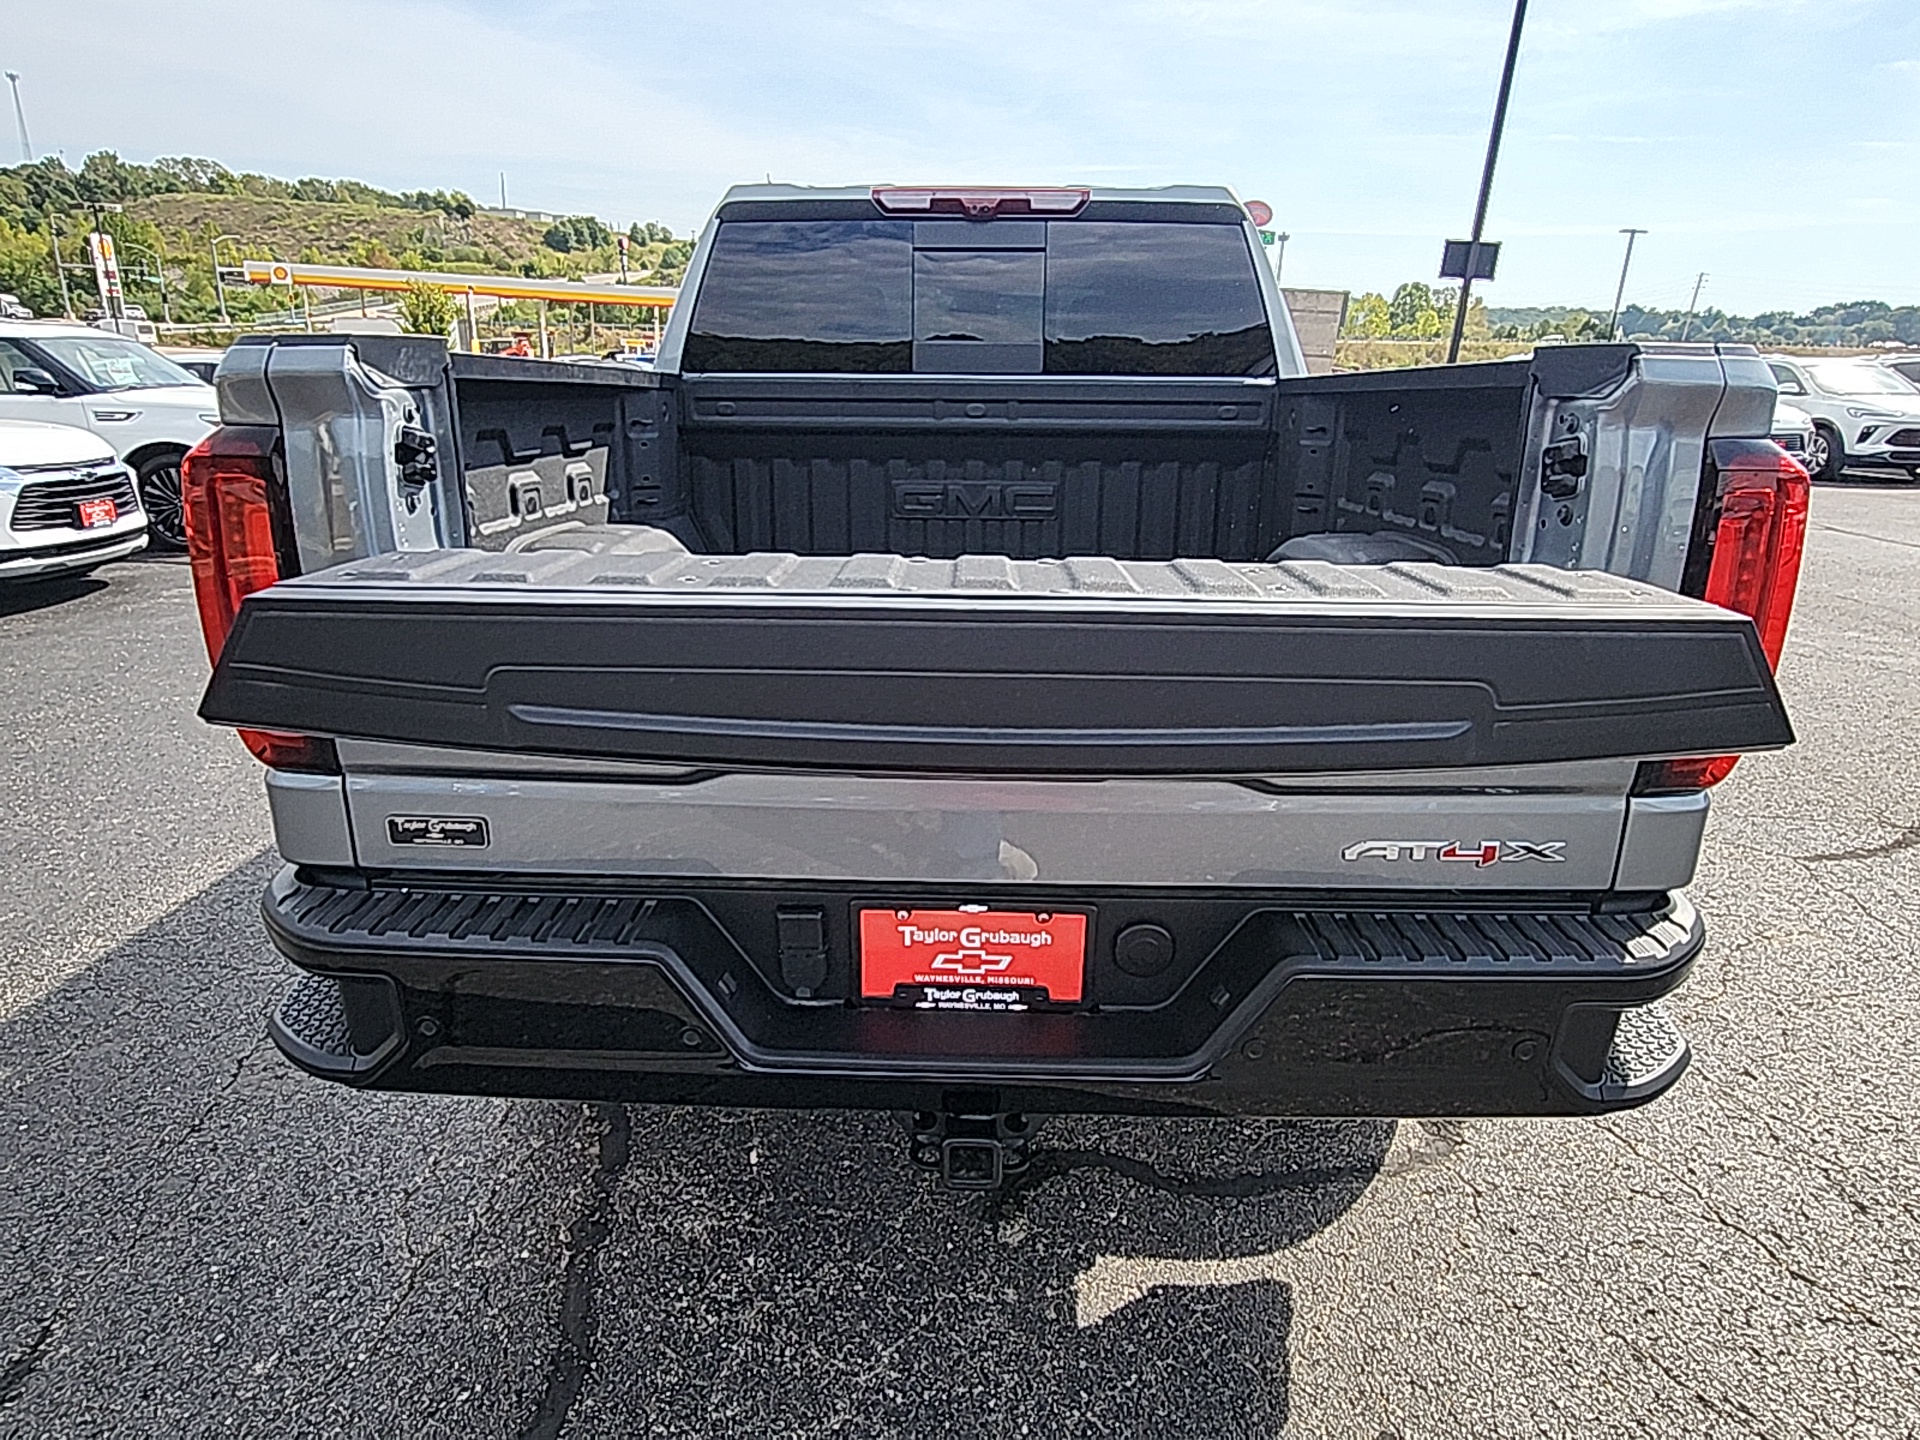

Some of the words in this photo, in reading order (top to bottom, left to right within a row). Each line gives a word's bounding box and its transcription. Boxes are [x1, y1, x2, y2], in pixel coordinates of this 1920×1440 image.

[892, 480, 1057, 520] GMC
[1342, 840, 1567, 868] AT4X
[897, 925, 958, 946] Taylor
[959, 927, 1052, 948] Grubaugh
[987, 976, 1034, 985] MISSOURI
[924, 987, 961, 1001] Taylor
[962, 988, 1020, 1003] Grubaugh
